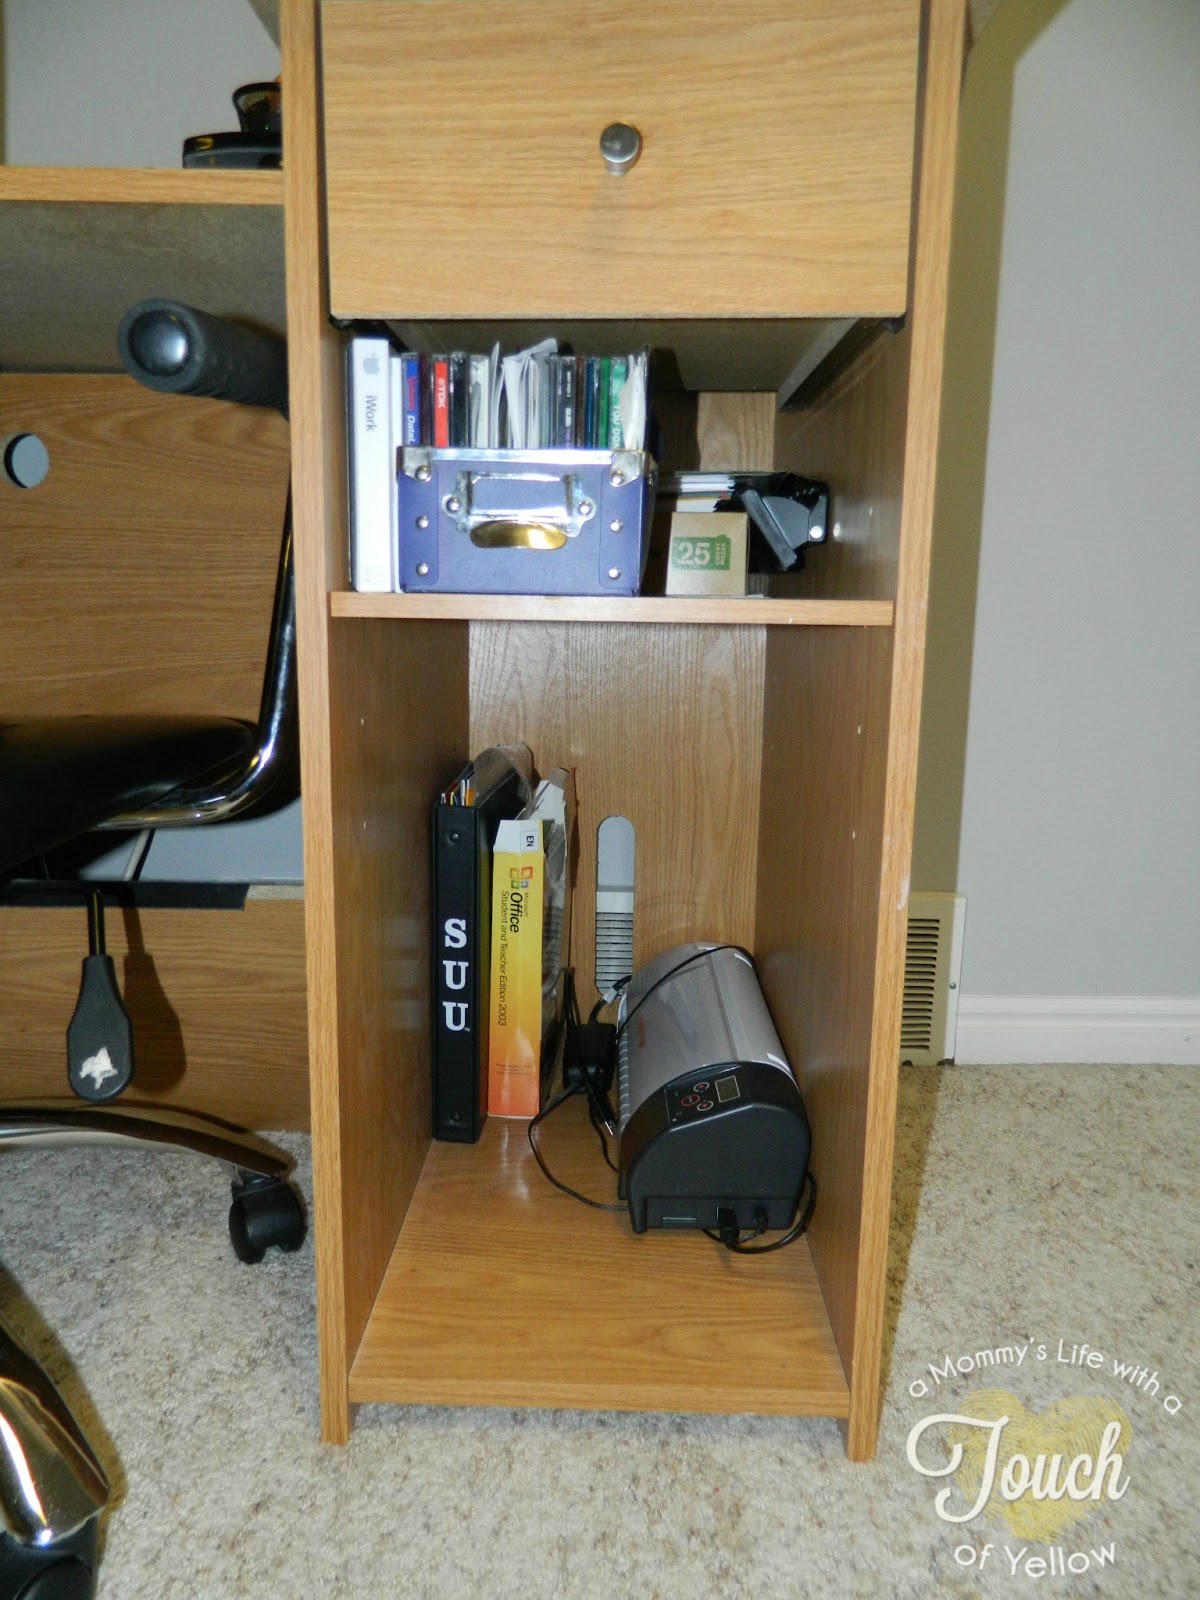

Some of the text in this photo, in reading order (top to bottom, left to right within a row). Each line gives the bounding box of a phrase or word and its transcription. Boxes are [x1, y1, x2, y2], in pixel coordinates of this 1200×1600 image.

[438, 386, 446, 408] TDK
[365, 395, 377, 432] iWork
[677, 542, 711, 566] 25
[526, 835, 534, 847] EN
[509, 892, 523, 933] Office
[498, 890, 510, 1026] Student and Teacher Edition 2003
